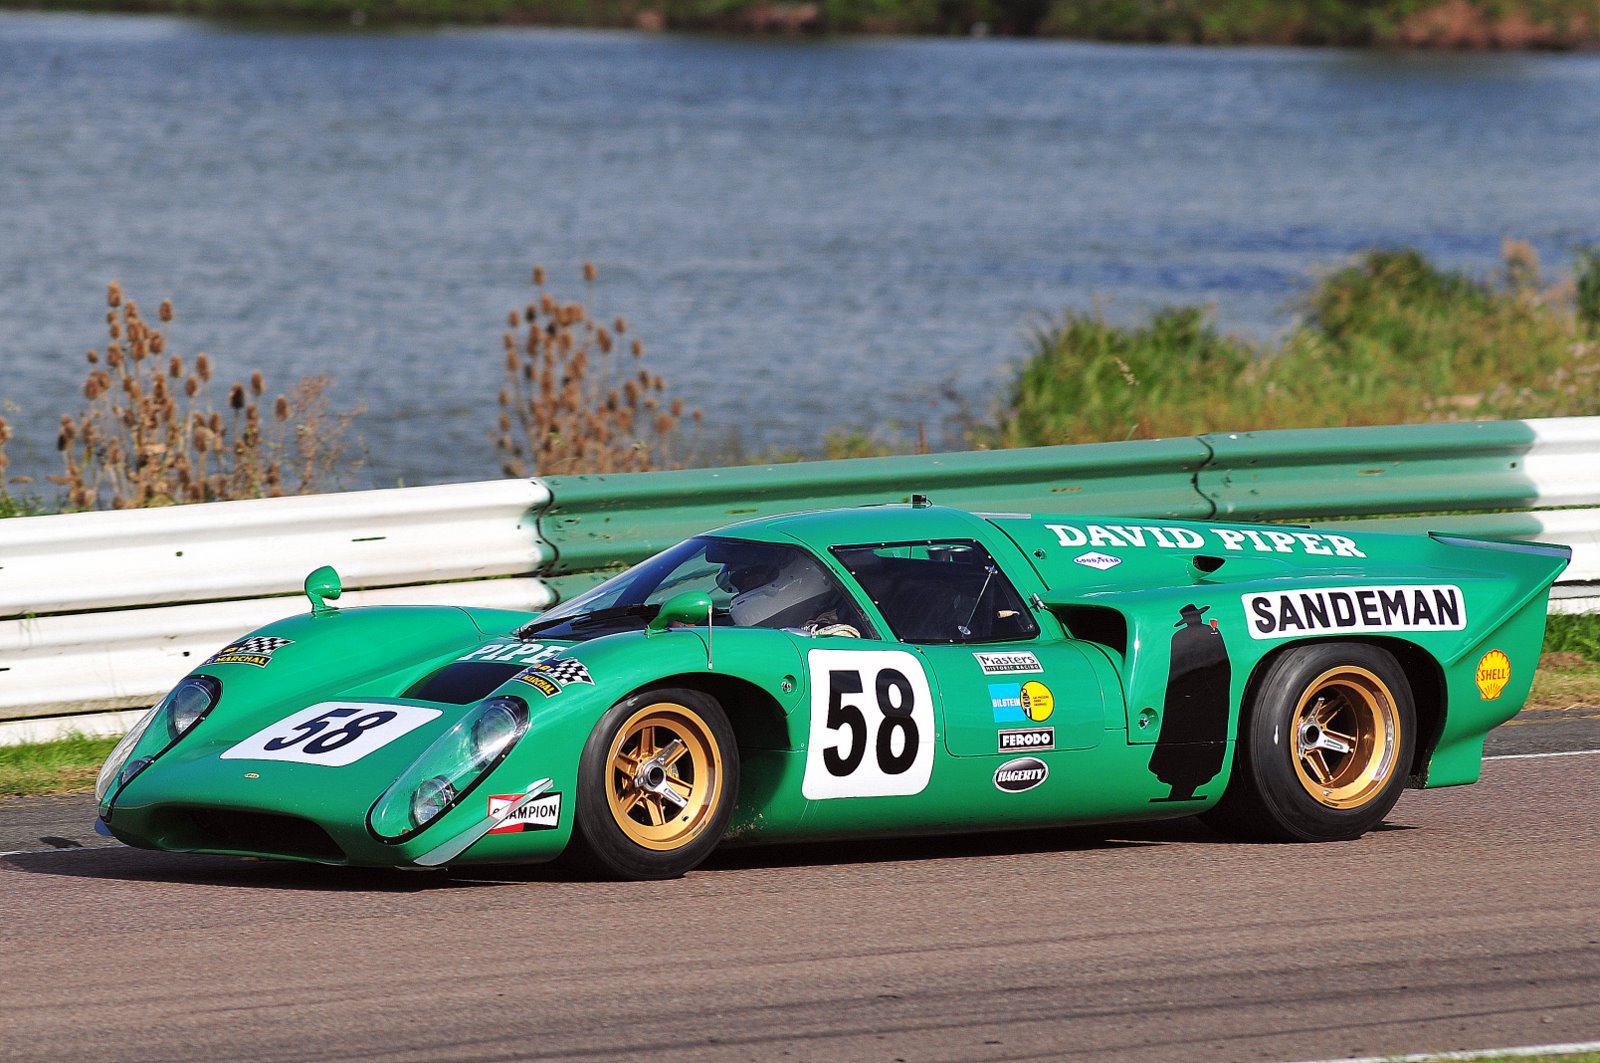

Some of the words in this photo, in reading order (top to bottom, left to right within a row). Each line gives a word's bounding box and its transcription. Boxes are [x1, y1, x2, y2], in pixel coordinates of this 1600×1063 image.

[1044, 524, 1205, 549] DAVID
[1209, 528, 1367, 558] PIPER
[1251, 589, 1460, 633] SANDEMAN
[215, 655, 265, 665] MARCHAL
[979, 655, 1035, 665] Masters
[984, 664, 1014, 672] HISTORIC
[1480, 668, 1507, 681] SHELL
[522, 674, 555, 695] MARCHAL
[992, 698, 1021, 708] BILSTEIN
[823, 667, 919, 777] 58
[263, 708, 398, 755] 58
[1002, 732, 1051, 747] FERODO
[997, 768, 1044, 782] HAGERTY
[492, 804, 557, 821] CAMPION
